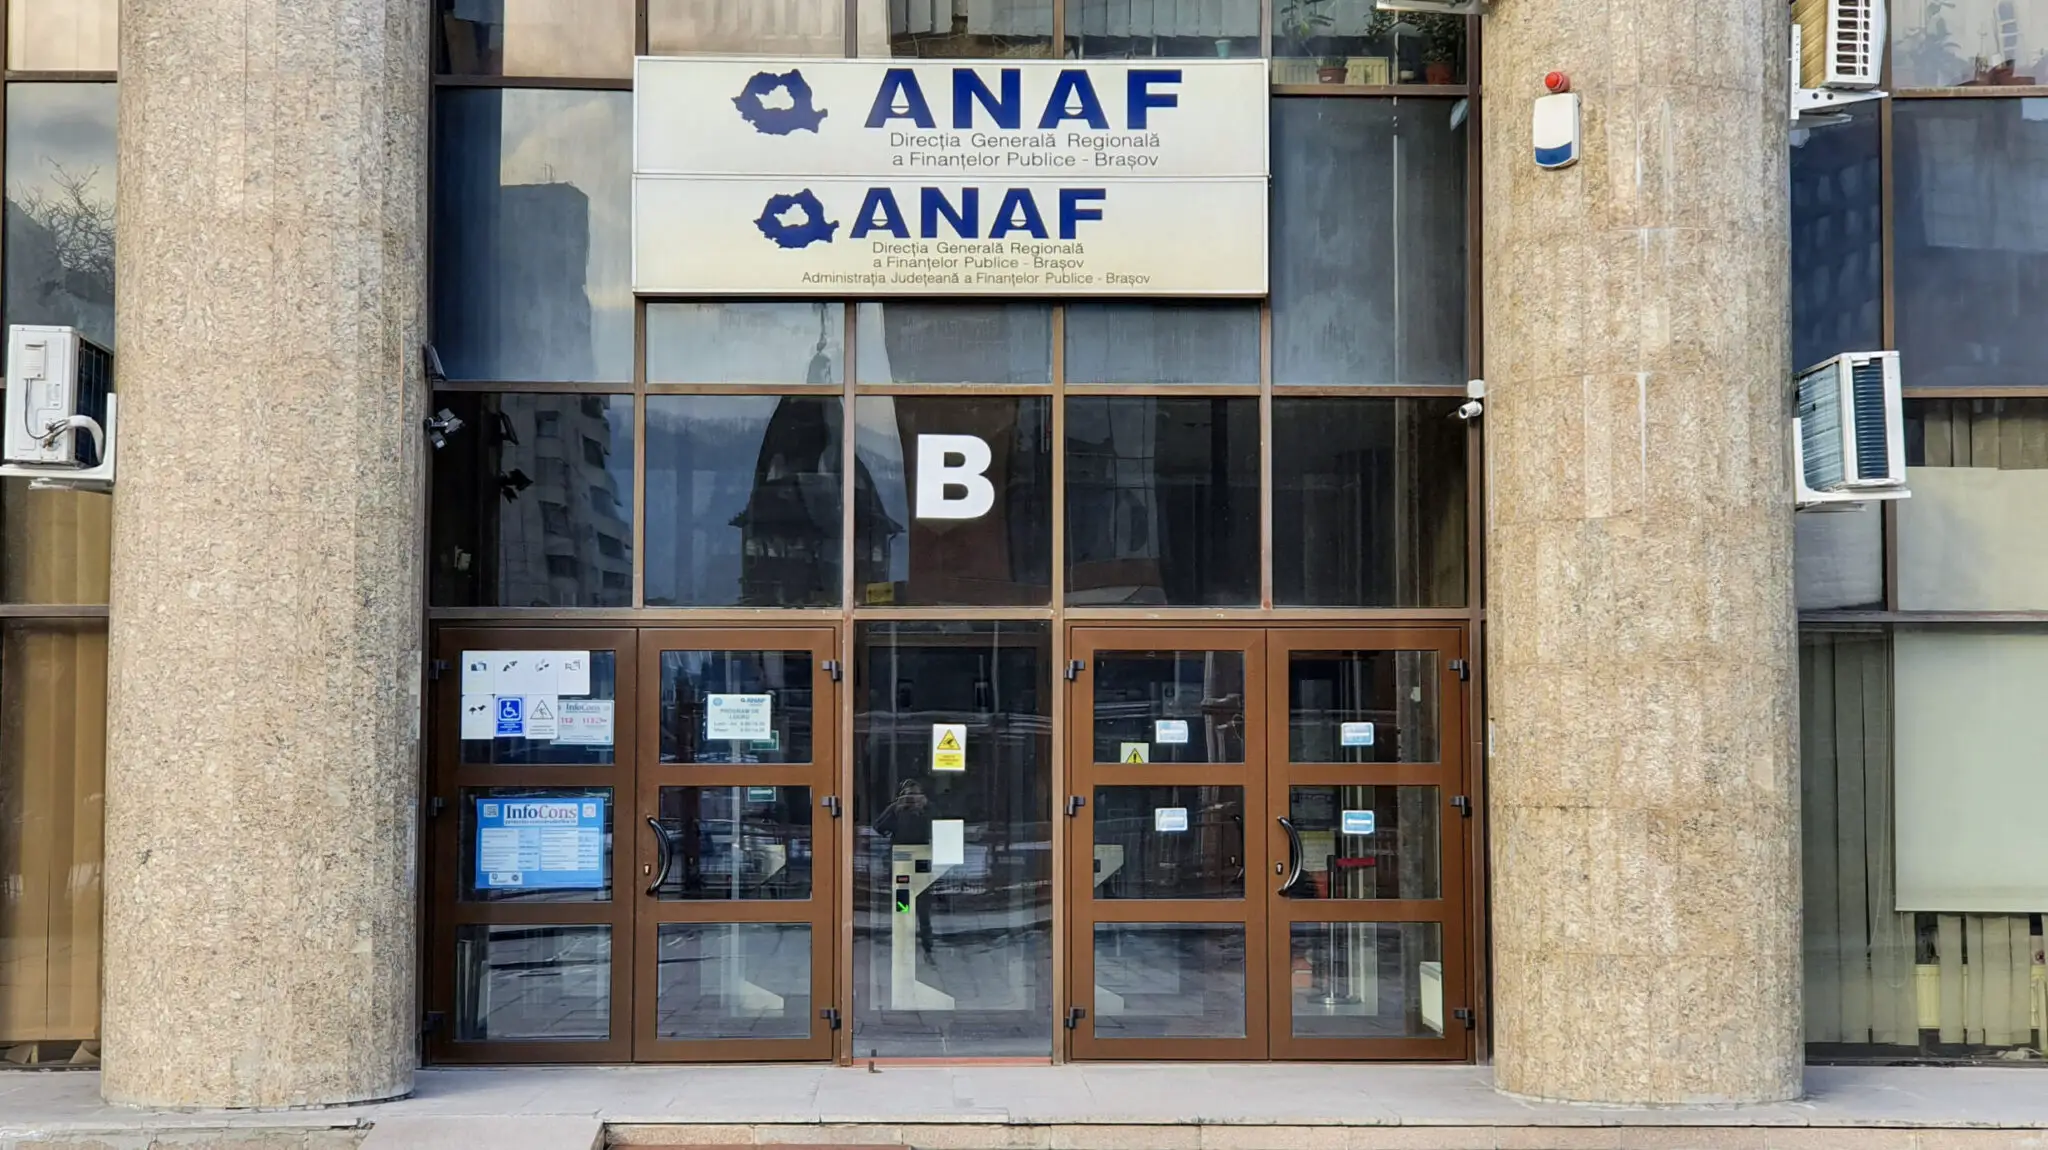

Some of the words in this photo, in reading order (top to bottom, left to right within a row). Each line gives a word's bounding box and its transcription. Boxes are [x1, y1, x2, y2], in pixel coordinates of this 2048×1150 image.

[864, 68, 1183, 130] ANAF
[890, 132, 961, 151] Direcția
[971, 132, 1056, 148] Generală
[1068, 133, 1161, 151] Regională
[892, 155, 904, 167] a
[910, 152, 1000, 170] Finanțelor
[1007, 152, 1076, 167] Publice
[1095, 152, 1159, 170] Brașov
[850, 187, 1107, 240] ANAF
[873, 242, 929, 257] Direcția
[936, 242, 1004, 254] Generală
[1011, 242, 1085, 257] Regională
[873, 258, 882, 268] a
[887, 256, 958, 271] Finanțelor
[965, 257, 1019, 268] Publice
[1034, 257, 1085, 271] Brașov
[802, 272, 886, 287] Administrația
[891, 272, 960, 287] Județeană
[964, 274, 973, 284] a
[976, 272, 1040, 287] Finanțelor
[1046, 272, 1093, 284] Publice
[1106, 272, 1151, 287] Brașov
[916, 434, 995, 519] B
[506, 804, 577, 819] InfoCons
